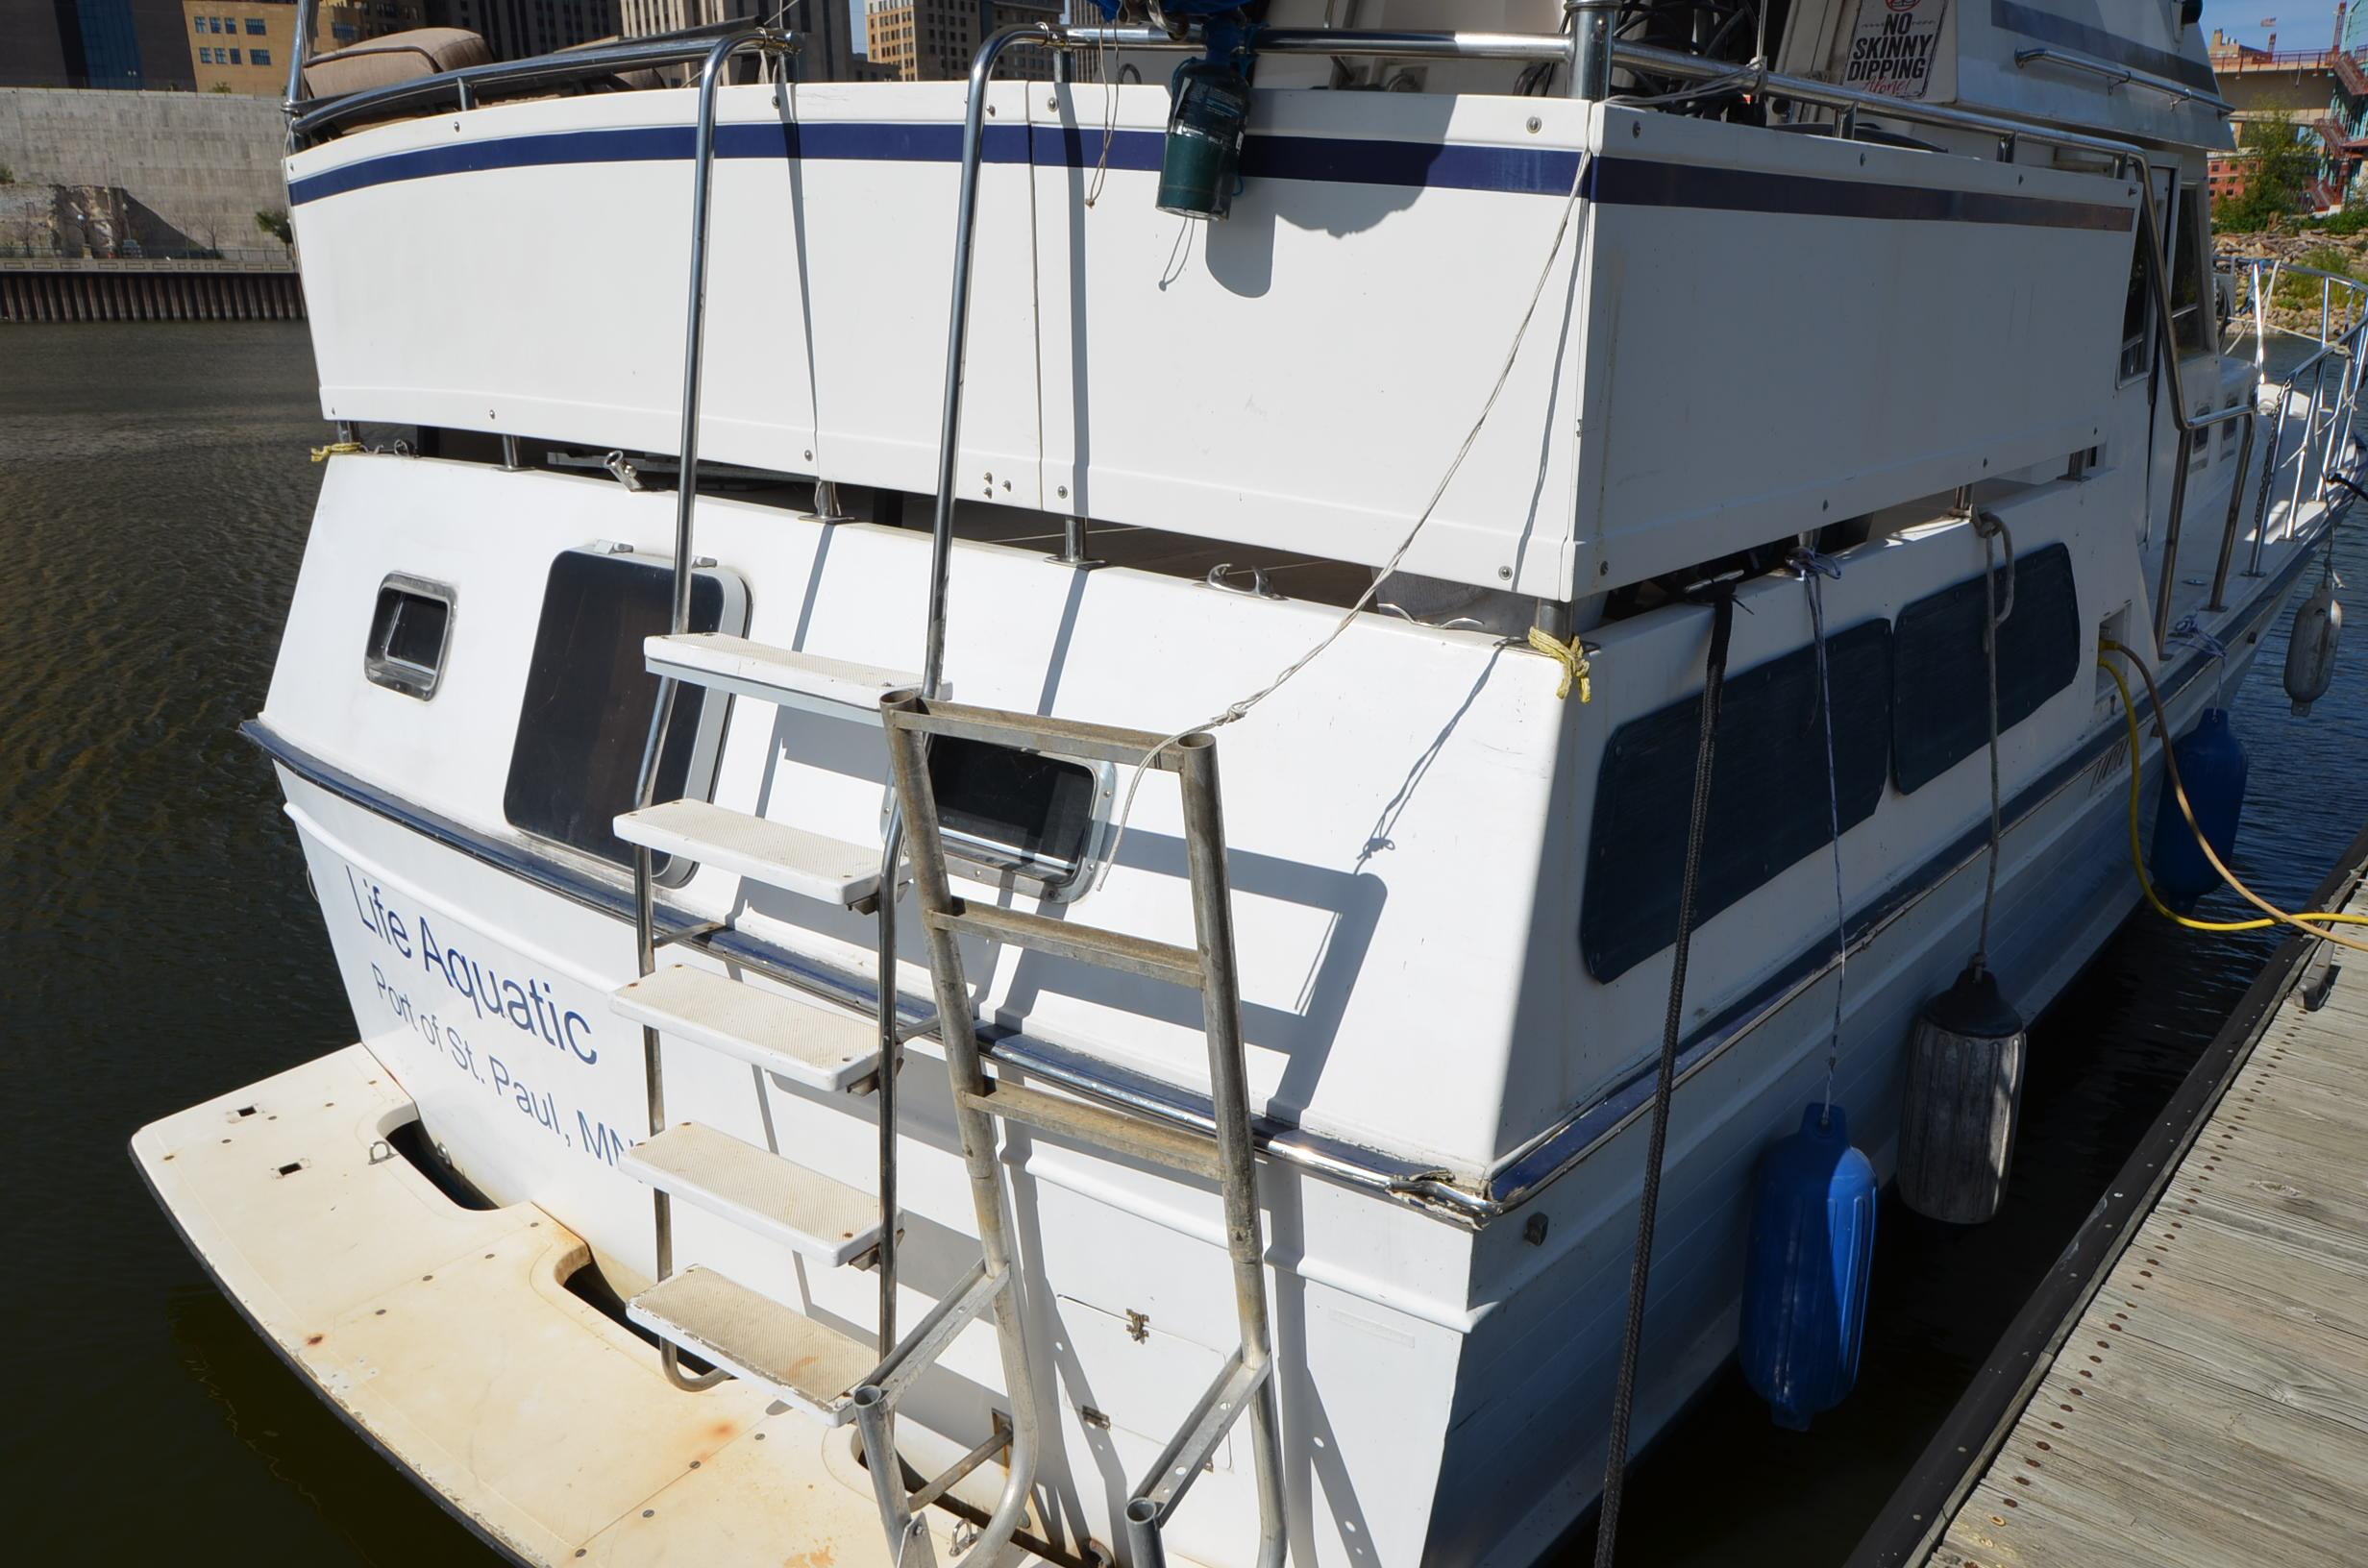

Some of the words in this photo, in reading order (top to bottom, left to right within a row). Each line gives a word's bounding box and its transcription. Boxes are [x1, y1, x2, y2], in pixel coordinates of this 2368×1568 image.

[1883, 12, 1912, 36] NO
[1853, 34, 1934, 60] SKINNY
[1847, 58, 1926, 82] DIPPING
[345, 865, 412, 959] Life
[420, 916, 598, 1066] Aquatic
[371, 962, 418, 1032] Port
[421, 1014, 444, 1053] of
[447, 1027, 486, 1085] St.
[488, 1054, 571, 1148] Paul,
